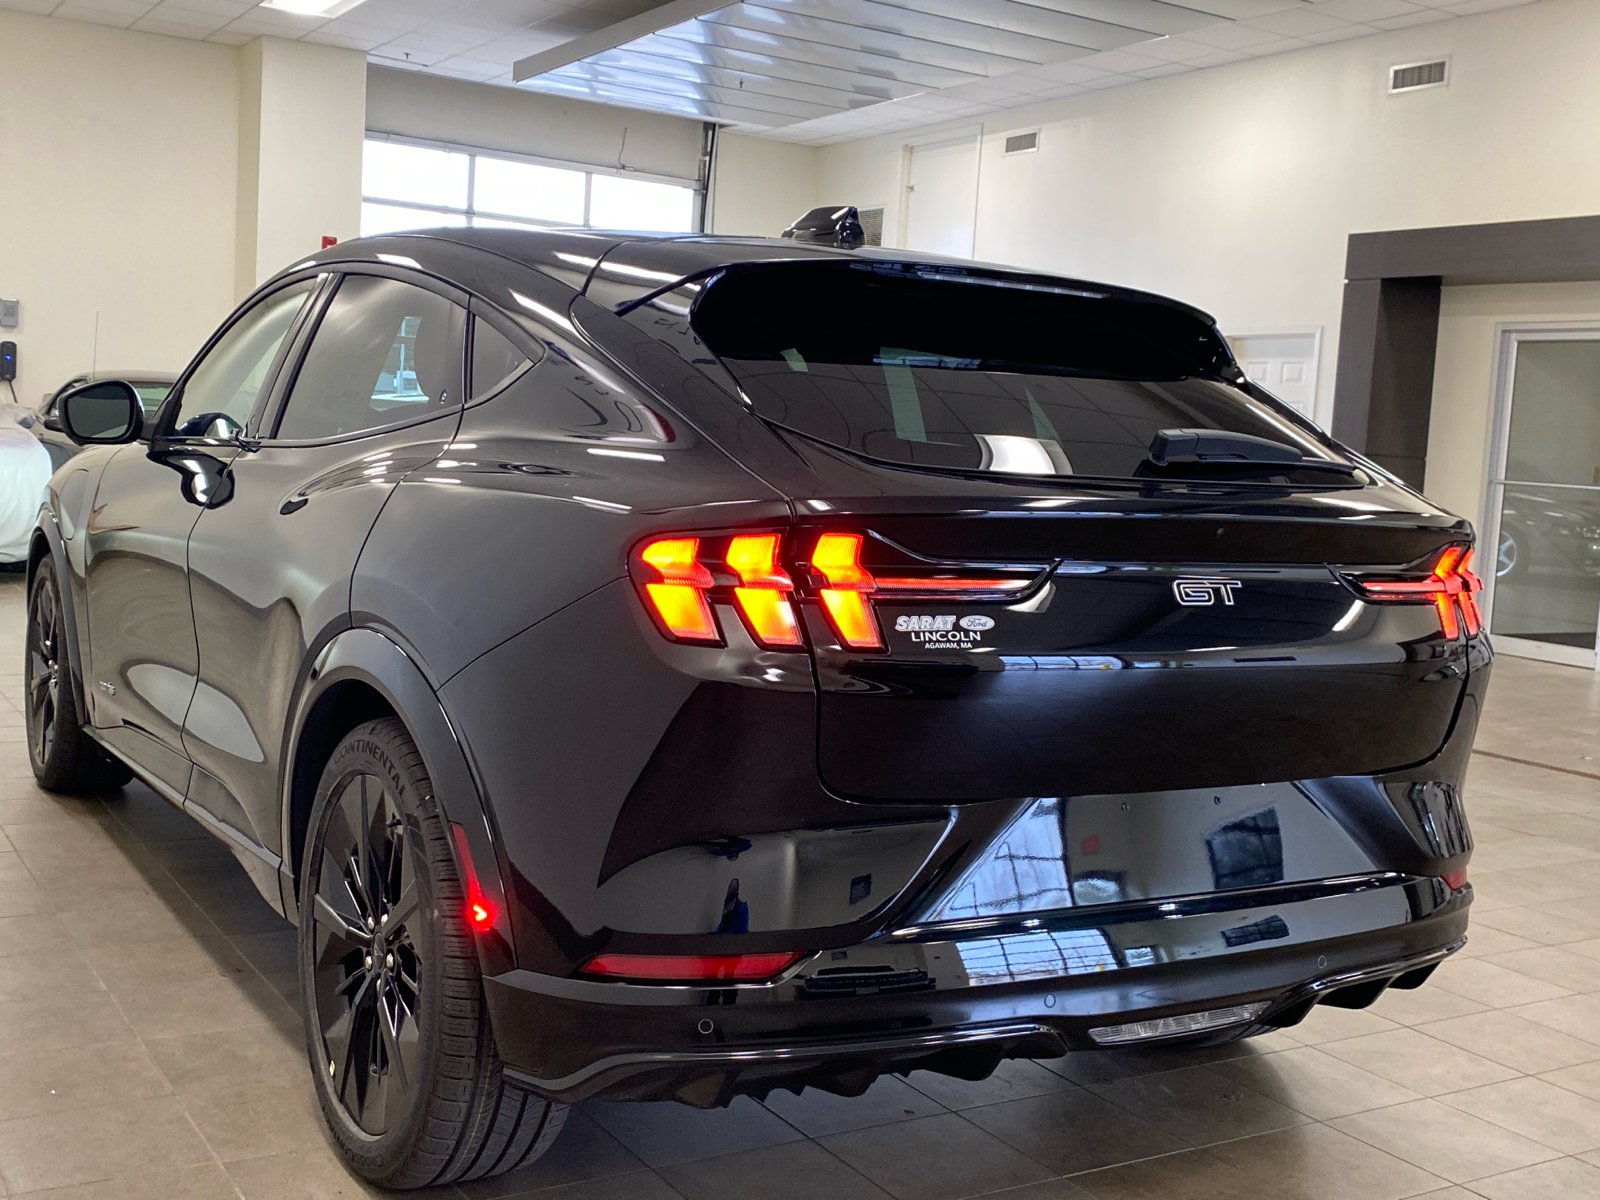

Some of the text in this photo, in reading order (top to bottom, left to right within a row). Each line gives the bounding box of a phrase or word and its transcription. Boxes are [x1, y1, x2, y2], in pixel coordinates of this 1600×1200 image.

[1173, 580, 1242, 605] GT
[895, 615, 956, 631] SARAT
[911, 631, 981, 641] LINCOLN
[333, 739, 406, 804] CONTINENTAL
